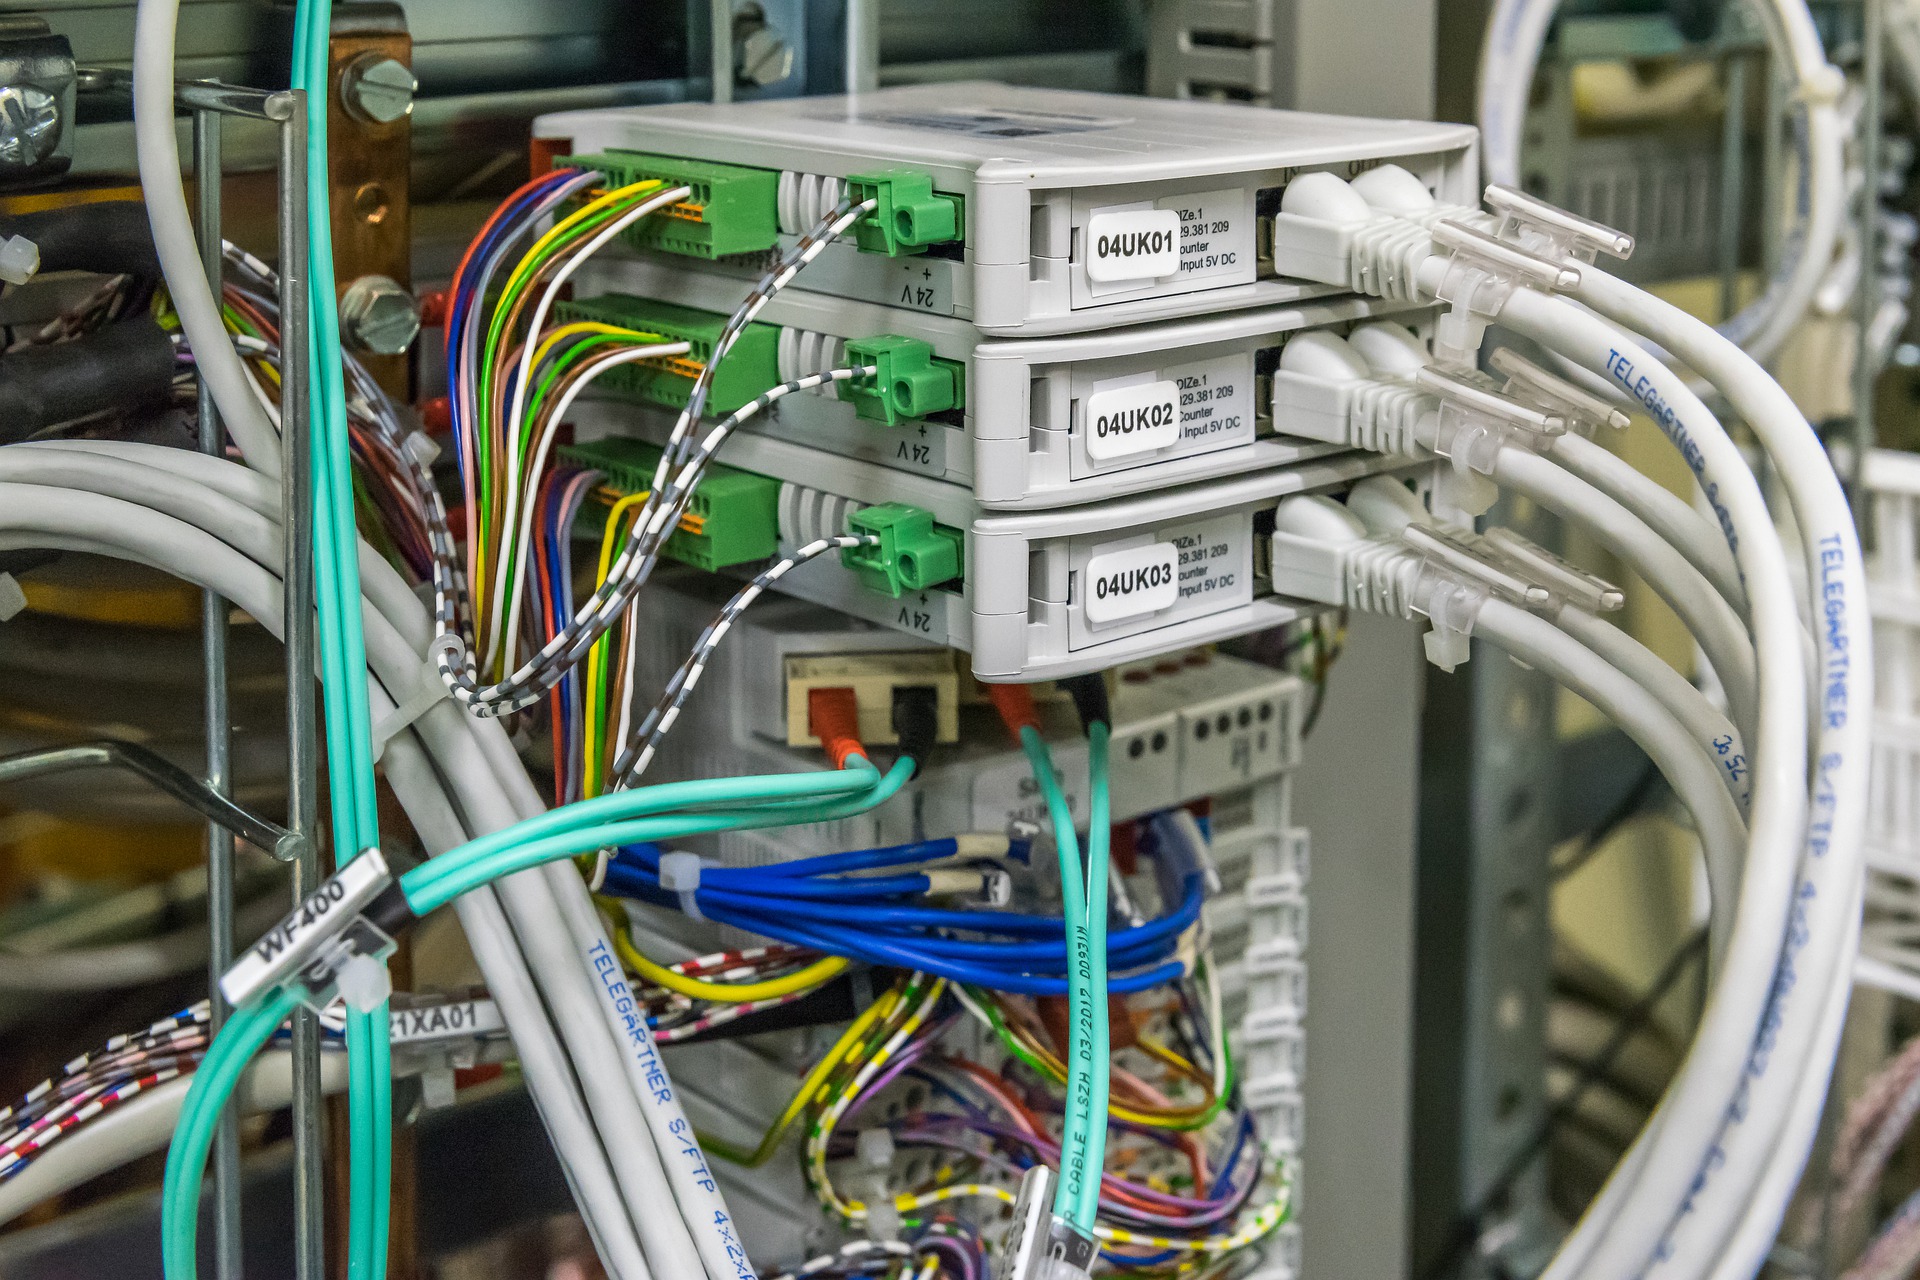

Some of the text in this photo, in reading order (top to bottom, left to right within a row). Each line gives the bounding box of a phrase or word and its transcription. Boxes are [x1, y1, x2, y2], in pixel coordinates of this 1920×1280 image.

[1177, 208, 1203, 222] IZe.1
[1180, 220, 1230, 238] 29.381 209
[1097, 230, 1173, 259] 04UK01
[1179, 241, 1210, 255] ounter
[1180, 252, 1237, 273] Input 5V DC
[901, 284, 935, 308] 24 V
[1176, 374, 1208, 391] DIZe.1
[1179, 384, 1234, 407] 29.381 209
[1096, 402, 1174, 439] 04UK02
[1184, 424, 1208, 440] Input
[1210, 419, 1224, 433] 5V
[1225, 415, 1241, 430] DC
[897, 440, 930, 466] 24 V
[1178, 543, 1229, 565] 29.381 209
[1096, 562, 1173, 601] 04UK03
[1178, 566, 1209, 582] ounter
[1178, 574, 1235, 599] Input 5V DC
[898, 606, 931, 633] 24 V
[255, 879, 345, 965] WF400
[1079, 988, 1092, 1062] 03/2017
[588, 937, 673, 1105] TELEGÄRTNER
[668, 1117, 716, 1194] S/FTP
[1076, 1071, 1091, 1121] LSZH
[1067, 1133, 1088, 1197] CABLE
